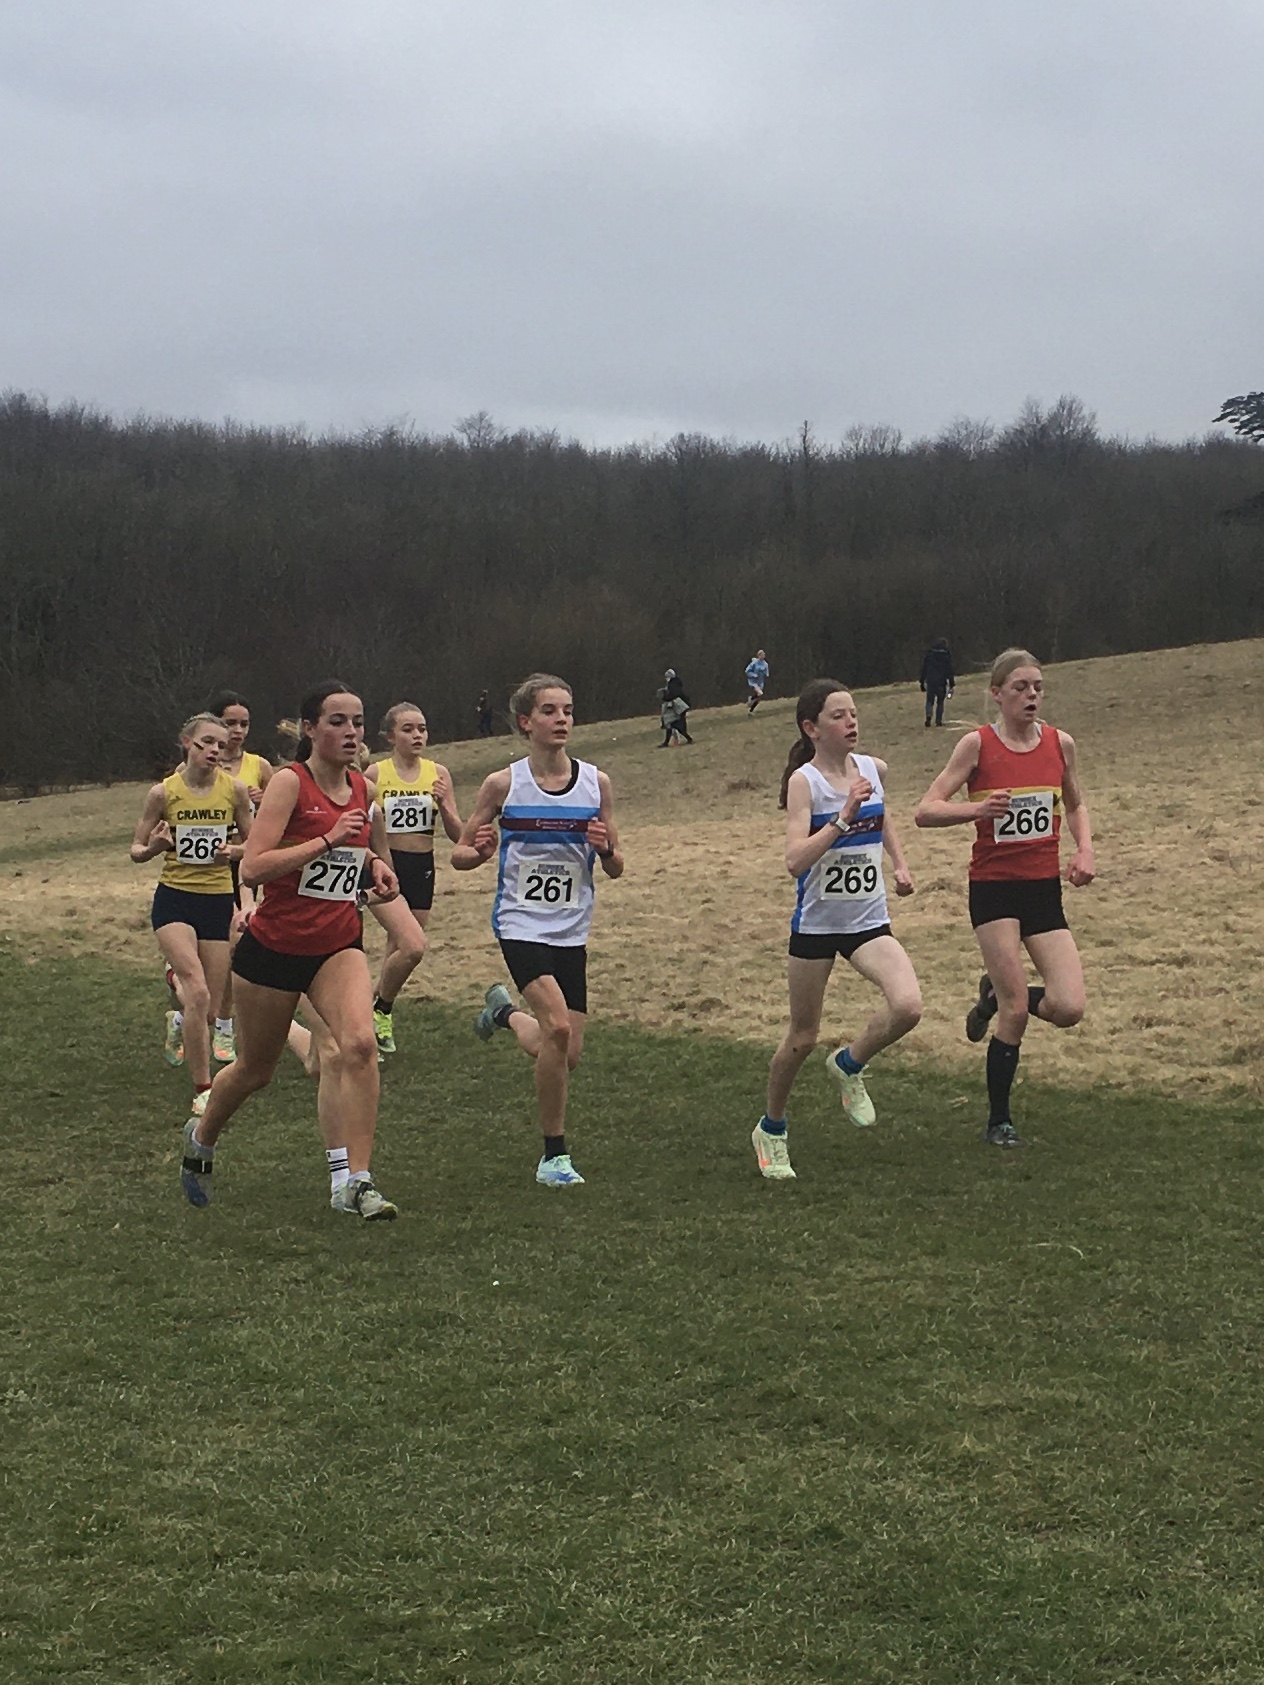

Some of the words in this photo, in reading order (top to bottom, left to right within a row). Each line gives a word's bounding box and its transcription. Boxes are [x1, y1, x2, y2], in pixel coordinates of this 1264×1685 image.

[177, 809, 227, 820] CRAWLEY
[391, 807, 427, 828] 281
[999, 806, 1049, 835] 266
[304, 861, 358, 894] 278
[524, 875, 573, 902] 261
[824, 865, 878, 894] 269
